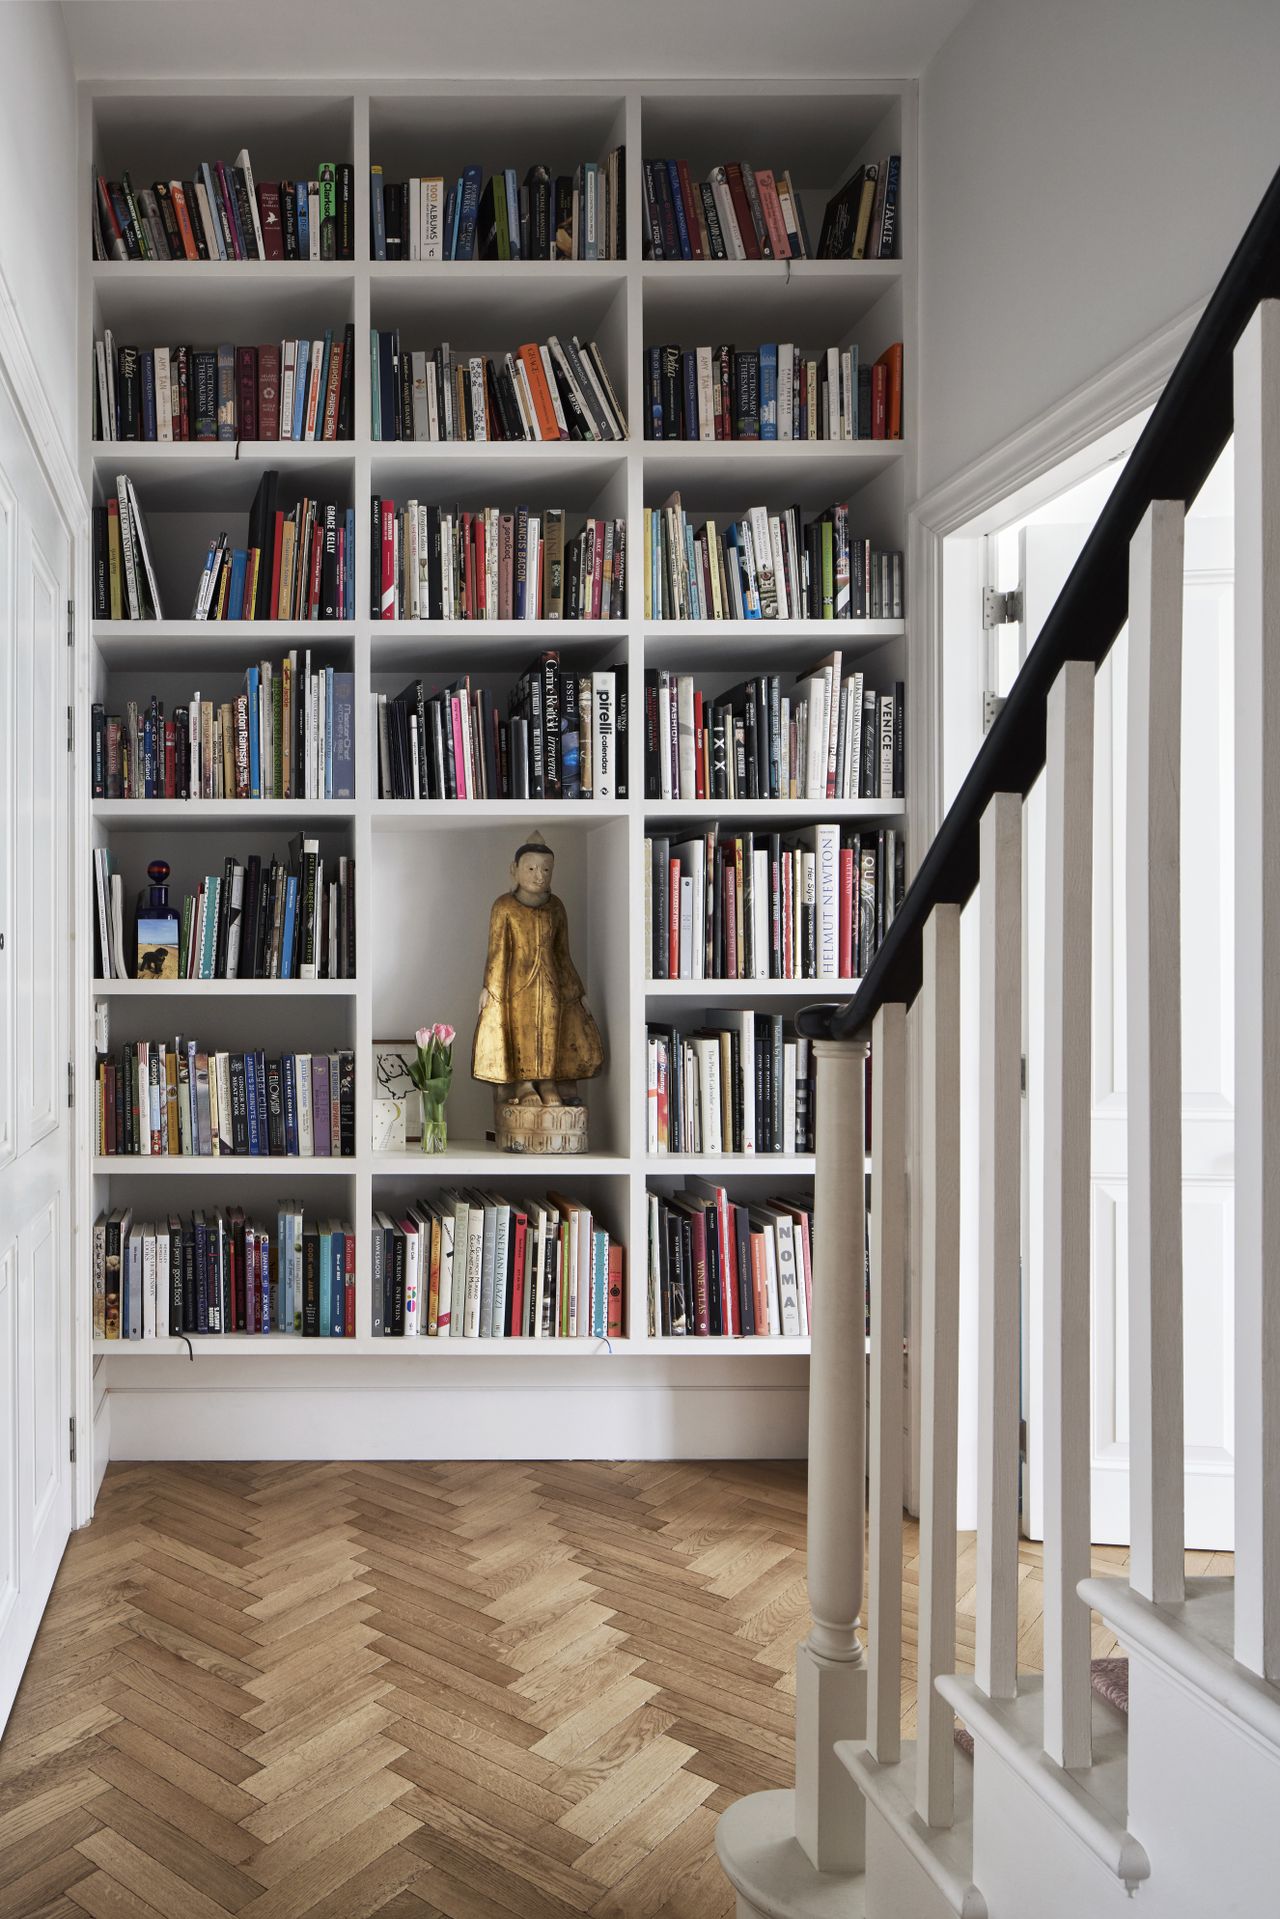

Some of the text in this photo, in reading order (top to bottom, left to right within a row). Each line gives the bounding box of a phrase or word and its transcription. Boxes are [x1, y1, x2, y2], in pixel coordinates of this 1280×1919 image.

[430, 204, 438, 240] ALBUMS
[884, 203, 895, 244] JAMIE
[125, 349, 136, 378] Delia
[667, 349, 678, 378] Delia
[326, 506, 336, 554] GRACE KELLY
[518, 511, 526, 582] FRANCIS BACON
[606, 526, 614, 560] DRINKS
[566, 680, 574, 712] PLESSI
[596, 691, 612, 735] pirelli
[237, 698, 248, 768] Gordon Ramsay
[546, 660, 558, 782] Carine Roitfeld irreverent
[882, 702, 892, 750] VENICE
[864, 856, 875, 901] QUAY
[822, 838, 834, 974] HELMUT NEWTON
[172, 1268, 182, 1288] good
[495, 1222, 506, 1309] VENETIAN PALAZZI
[174, 1288, 182, 1306] food
[698, 1288, 706, 1315] ATLAS
